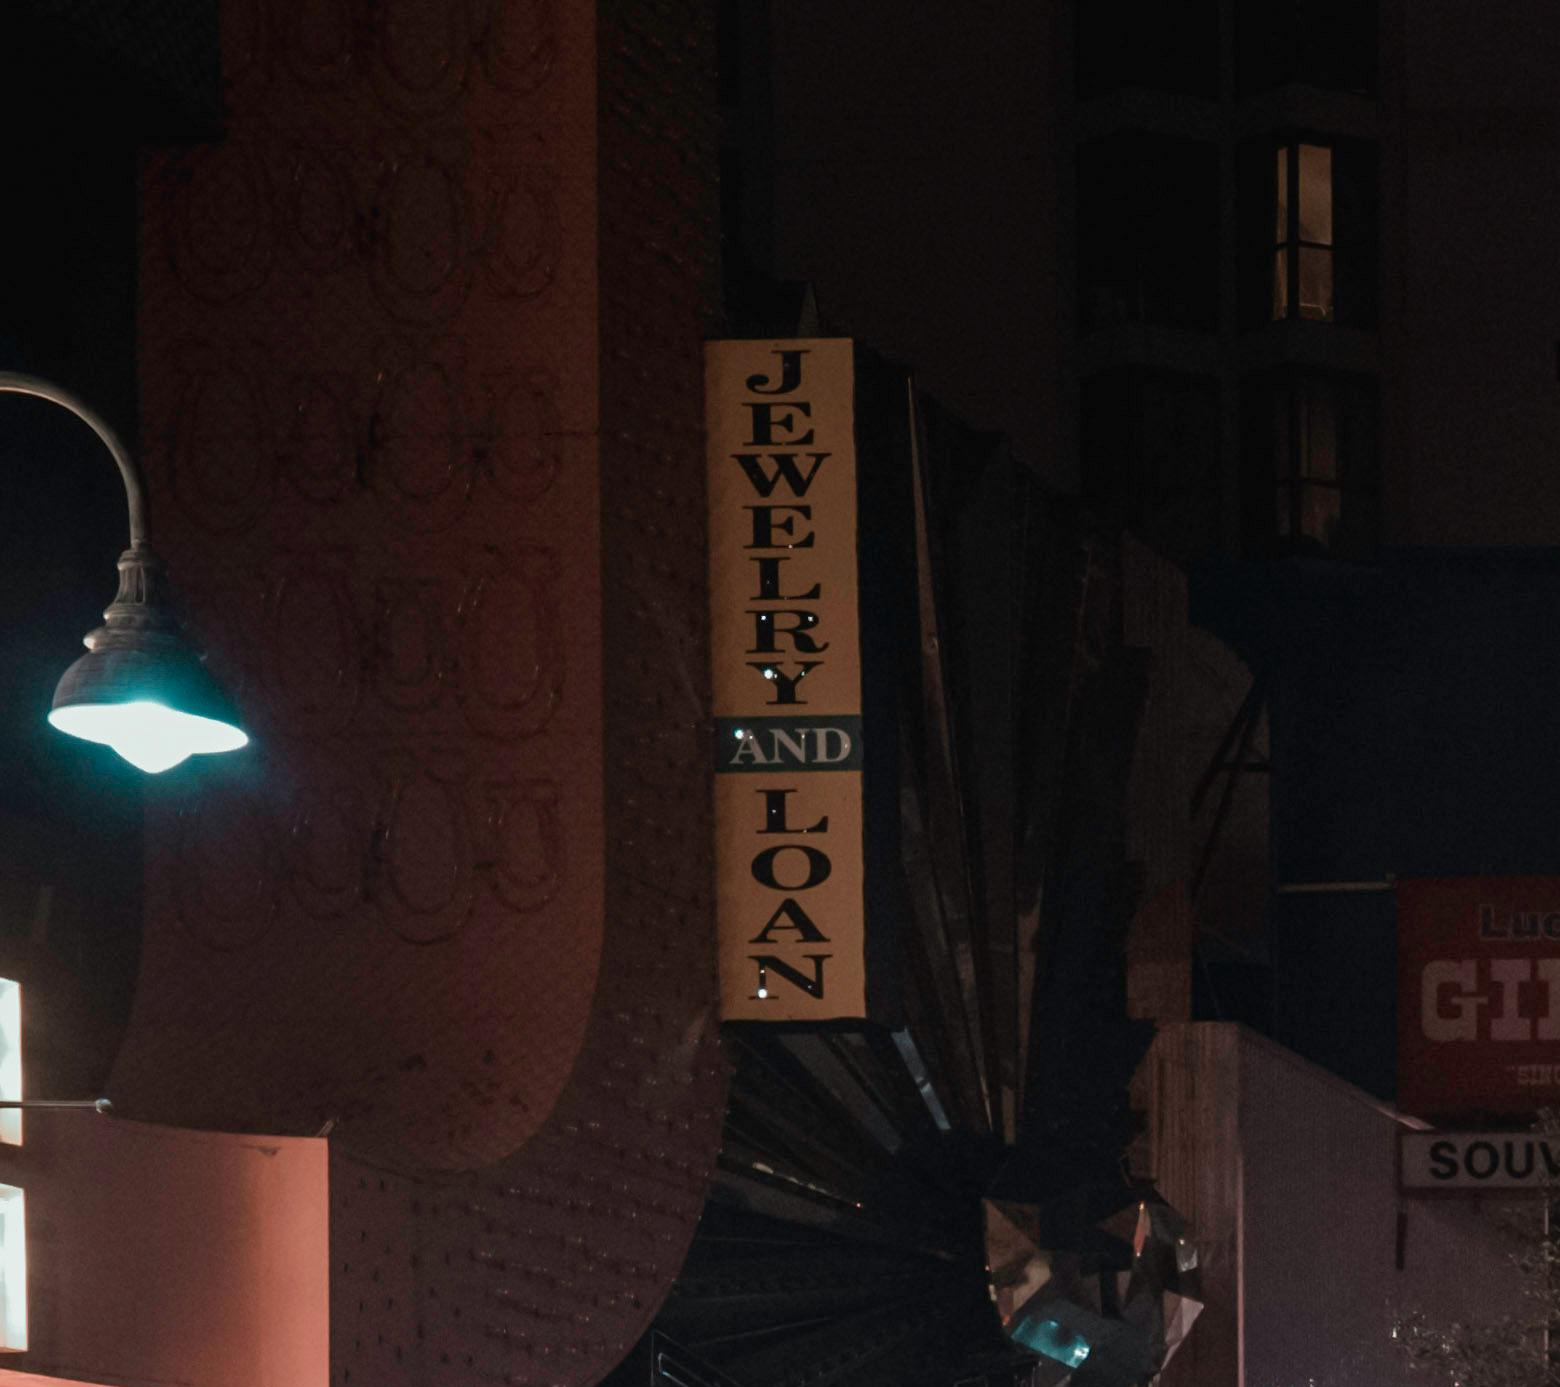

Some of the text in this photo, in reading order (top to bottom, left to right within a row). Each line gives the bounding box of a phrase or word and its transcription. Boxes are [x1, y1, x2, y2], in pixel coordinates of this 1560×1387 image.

[730, 349, 831, 706] JEWELRY
[729, 728, 852, 766] AND
[748, 789, 832, 1000] LOAN
